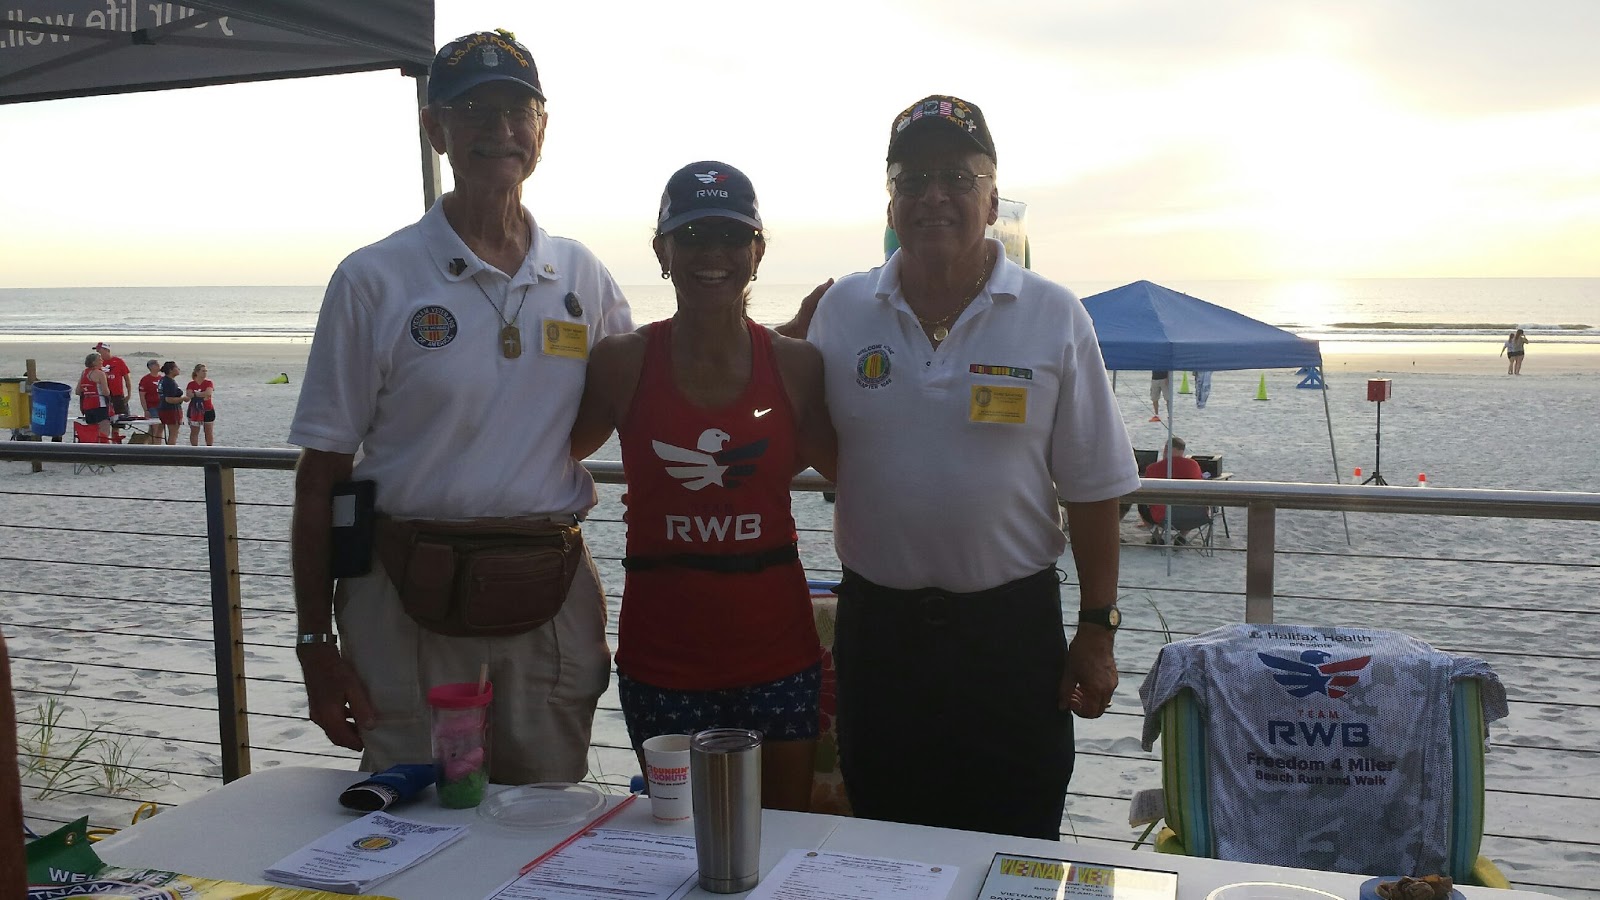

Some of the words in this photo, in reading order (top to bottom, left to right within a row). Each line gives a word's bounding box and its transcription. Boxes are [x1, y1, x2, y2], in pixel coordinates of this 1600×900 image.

[489, 35, 530, 68] FORCE
[696, 189, 729, 199] RWB
[665, 513, 762, 543] RWB
[1267, 631, 1319, 641] Halifax
[1321, 633, 1372, 642] Health
[1297, 708, 1340, 719] TEAM
[1267, 720, 1370, 748] RWB
[1246, 751, 1325, 771] Freedom
[1331, 758, 1342, 771] 4
[1349, 757, 1396, 772] Miler
[653, 773, 687, 782] DONUTS
[1254, 769, 1294, 783] Beach
[1297, 772, 1324, 785] Run
[1326, 774, 1350, 786] and
[1354, 775, 1387, 786] Walk
